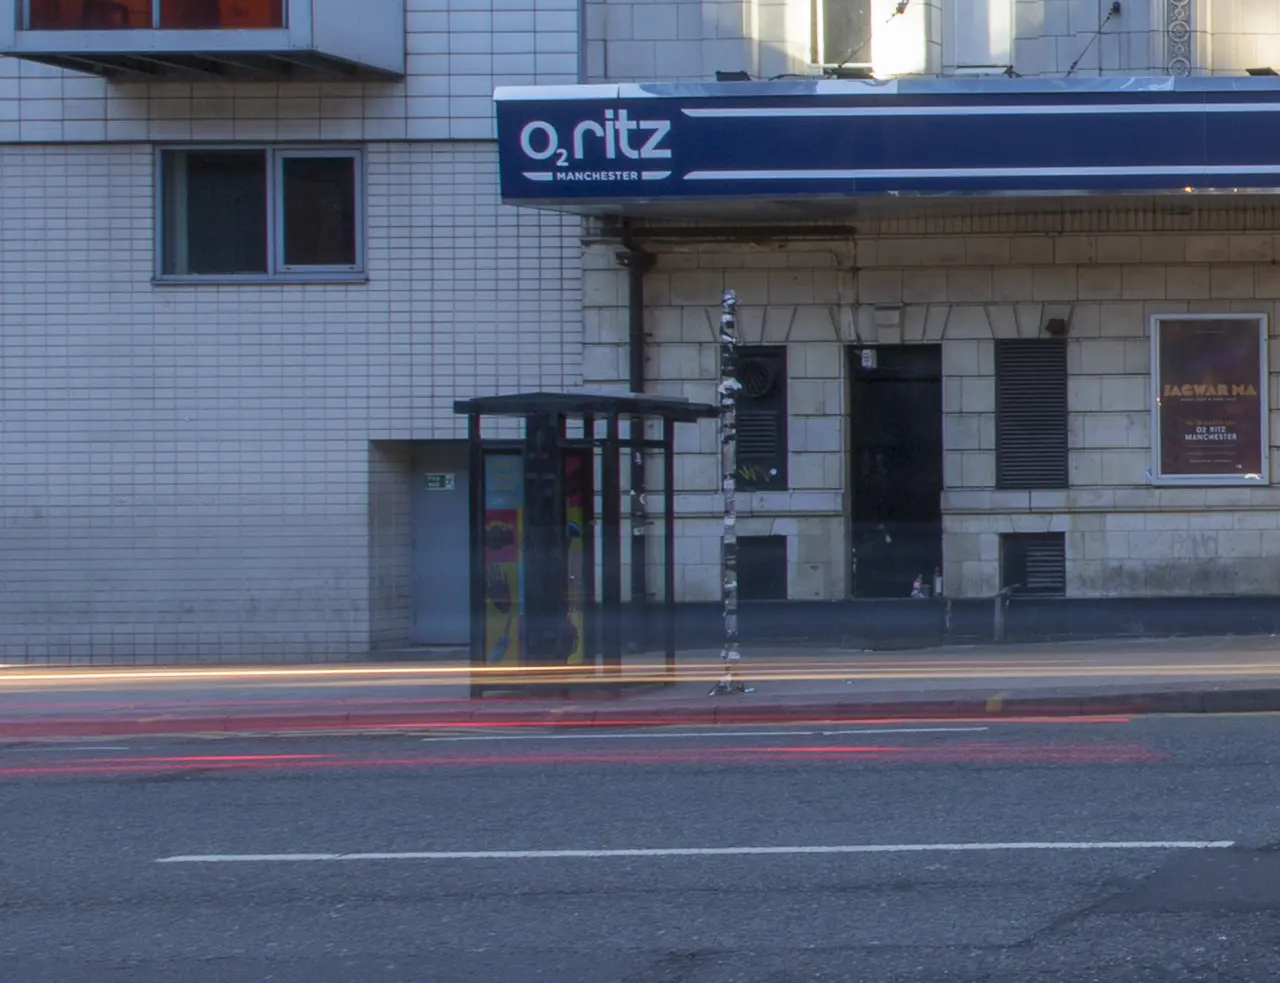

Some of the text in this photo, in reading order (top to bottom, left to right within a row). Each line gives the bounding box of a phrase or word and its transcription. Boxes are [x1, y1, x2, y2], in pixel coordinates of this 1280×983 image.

[556, 171, 638, 181] MANCHESTER
[1232, 384, 1257, 396] MA
[1184, 433, 1238, 441] MANCHESTER
